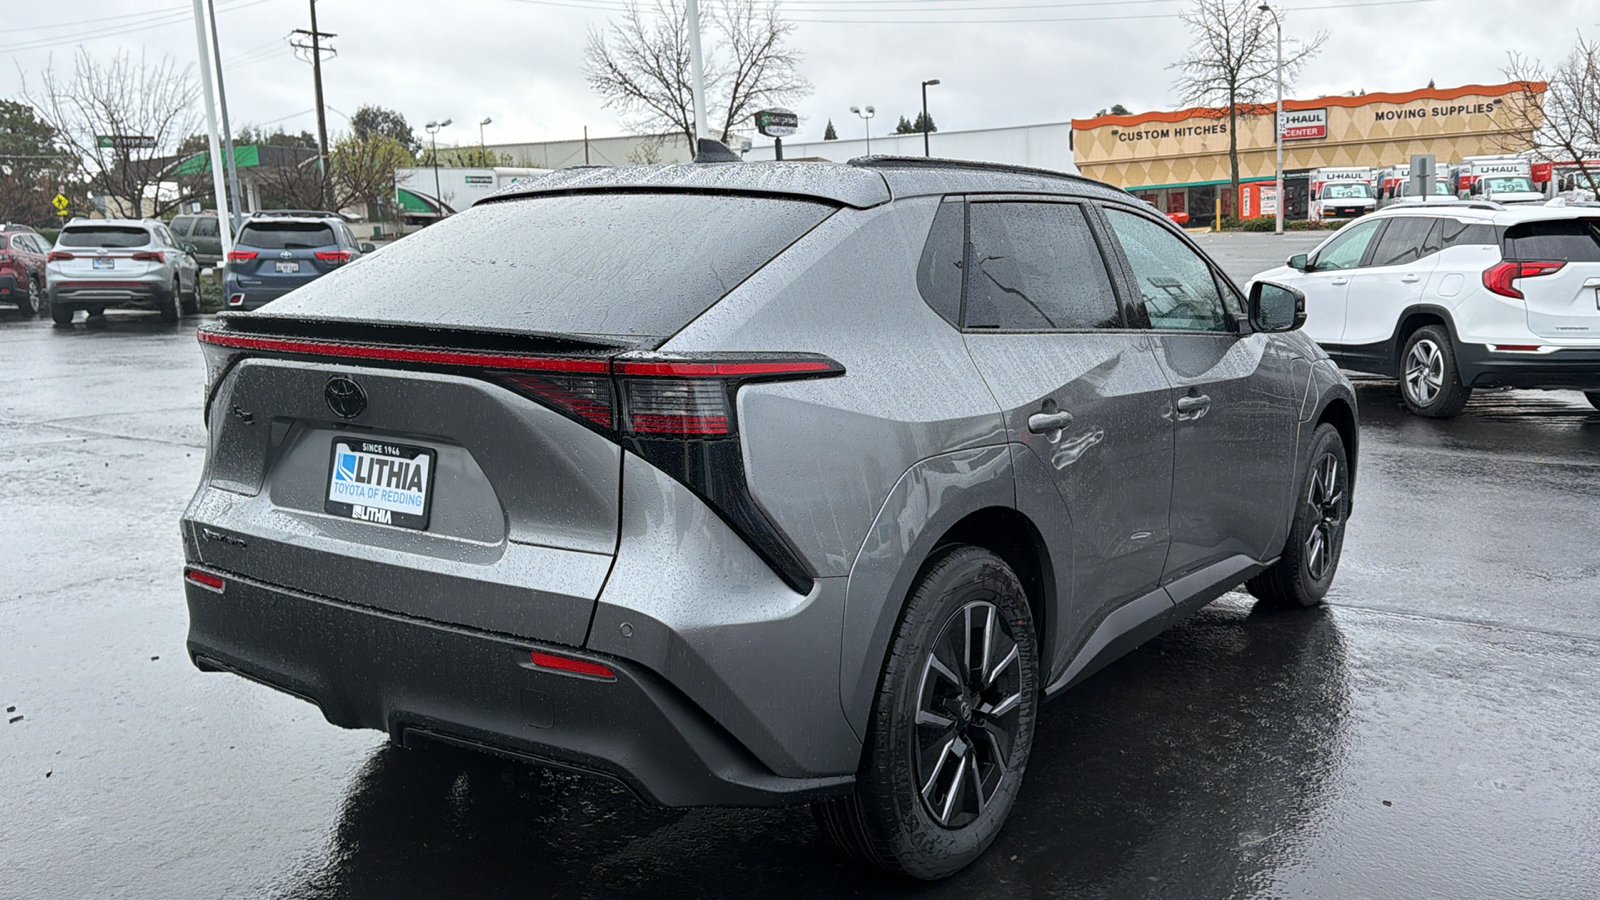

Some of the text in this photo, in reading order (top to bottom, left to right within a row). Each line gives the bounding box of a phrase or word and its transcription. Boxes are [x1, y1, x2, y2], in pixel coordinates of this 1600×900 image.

[1375, 103, 1494, 121] MOVING SUPPLIES
[1118, 124, 1227, 142] CUSTOM HITCHES
[1285, 128, 1318, 137] CENTER
[1480, 166, 1520, 174] U-HAUL
[362, 442, 400, 456] SINCE 1946
[355, 456, 423, 493] LITHIA
[334, 481, 422, 507] TOYOTA OF REDDING
[362, 505, 392, 525] LITHIA
